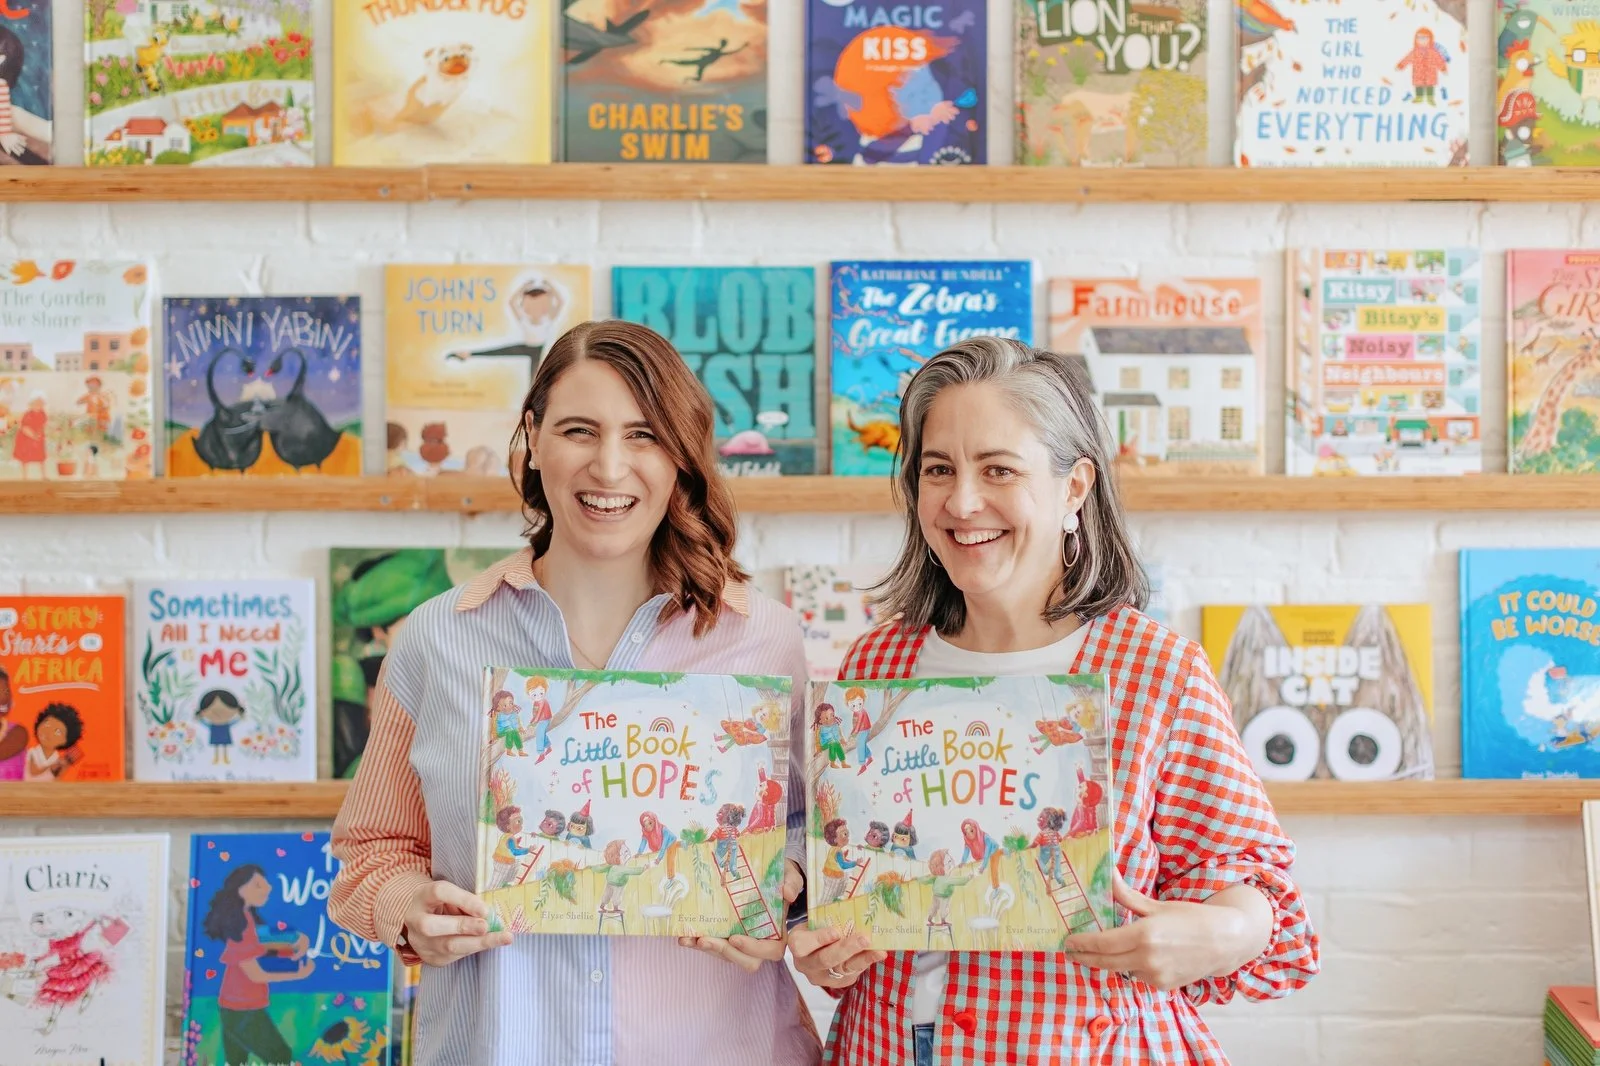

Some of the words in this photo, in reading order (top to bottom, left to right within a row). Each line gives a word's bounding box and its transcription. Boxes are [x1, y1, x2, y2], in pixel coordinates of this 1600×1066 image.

[844, 5, 943, 28] MAGIC
[1037, 0, 1126, 38] LION
[1127, 12, 1140, 27] IS
[1141, 19, 1174, 34] THAT
[1324, 18, 1357, 33] THE
[862, 36, 928, 60] KISS
[1096, 22, 1202, 72] YOU?
[1321, 41, 1363, 57] GIRL
[1322, 64, 1361, 79] WHO
[1296, 86, 1392, 106] NOTICED
[588, 102, 744, 131] CHARLIE'S
[1257, 111, 1449, 143] EVERYTHING
[620, 132, 710, 160] SWIM
[1, 288, 33, 307] The
[40, 289, 107, 309] Garden
[404, 277, 497, 301] JOHN'S
[860, 286, 897, 308] The
[899, 283, 998, 316] Zebra's
[1071, 286, 1241, 316] Farmhouse
[1328, 281, 1392, 303] Kitsy
[1, 312, 26, 328] We
[31, 311, 82, 328] Share
[417, 309, 484, 333] TURN
[1363, 308, 1441, 329] Bitsy's
[175, 311, 254, 362] NINNI
[850, 318, 929, 349] Great
[1349, 338, 1411, 358] Noisy
[1325, 364, 1444, 385] Neighbours
[148, 589, 292, 620] Sometimes
[1499, 591, 1521, 615] IT
[1526, 589, 1597, 618] COULD
[25, 605, 99, 630] STORY
[1491, 616, 1520, 640] BE
[161, 623, 188, 642] All
[199, 623, 209, 642] I
[219, 623, 281, 642] Need
[13, 656, 104, 684] AFRICA
[1263, 645, 1382, 680] INSIDE
[1280, 675, 1361, 706] CAT
[579, 712, 618, 730] The
[896, 719, 934, 738] The
[560, 736, 622, 766] Little
[626, 724, 697, 760] Book
[880, 744, 940, 776] Little
[943, 728, 1013, 766] Book
[571, 768, 592, 794] of
[601, 759, 722, 806] HOPES
[893, 777, 913, 804] of
[920, 764, 1041, 811] HOPES
[25, 863, 112, 893] Claris
[541, 910, 565, 922] Elyse
[566, 911, 594, 921] Shellie
[677, 914, 697, 923] Evie
[699, 915, 729, 923] Barrow
[1027, 926, 1057, 935] Barrow
